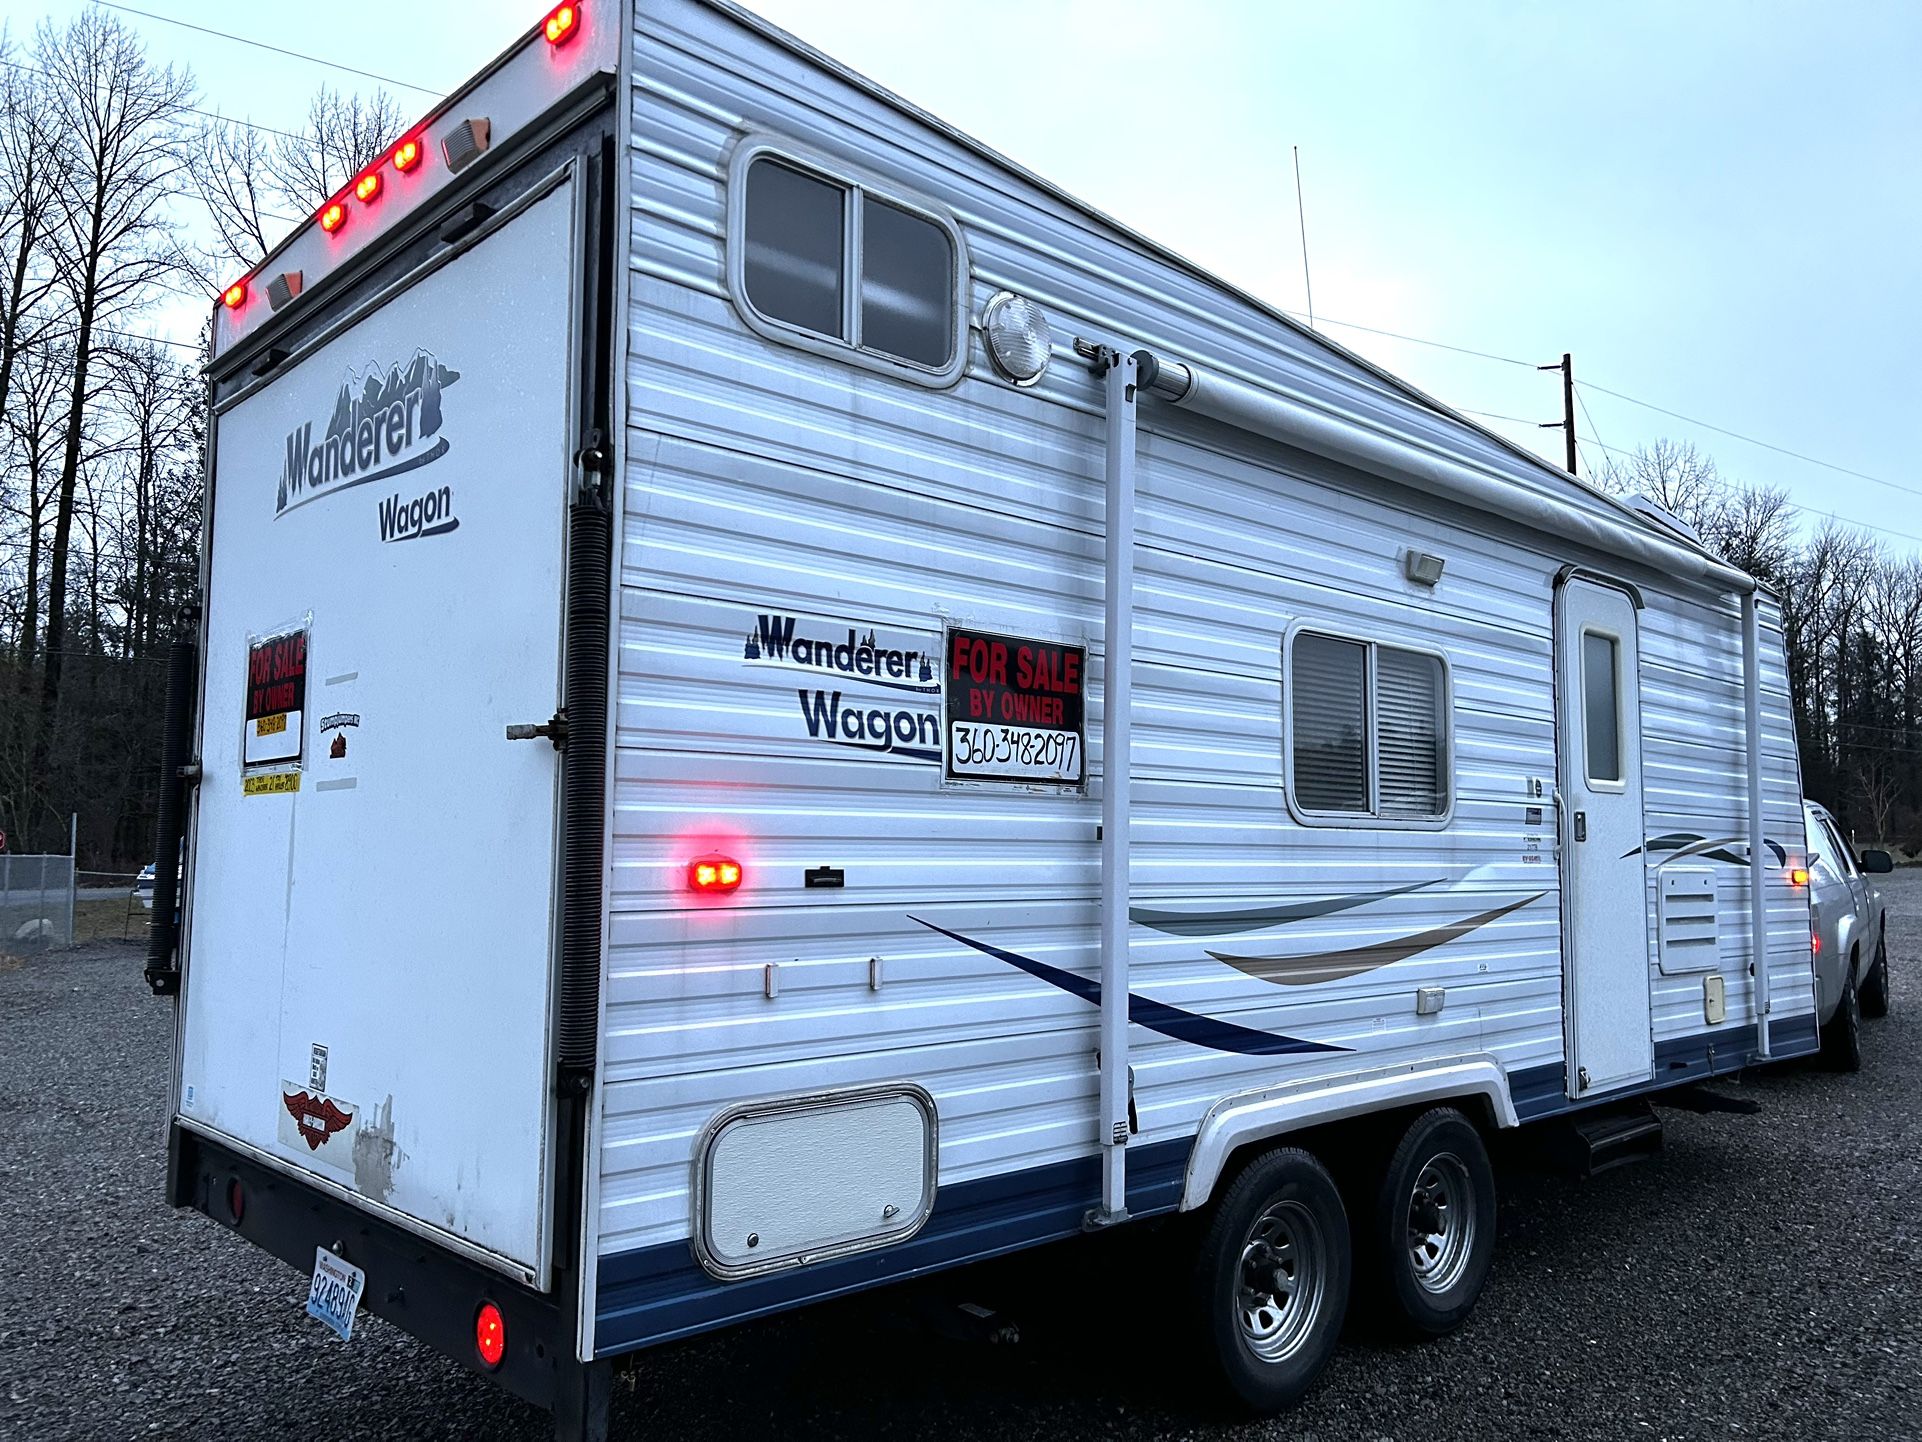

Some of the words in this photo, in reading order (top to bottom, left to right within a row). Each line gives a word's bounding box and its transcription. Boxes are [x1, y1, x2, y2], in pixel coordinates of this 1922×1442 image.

[286, 388, 422, 497] Wanderer
[378, 485, 451, 542] Wagon
[249, 646, 272, 687] FOR
[274, 636, 304, 681] SALE
[757, 613, 919, 679] Wanderer
[952, 637, 1007, 685] FOR
[1017, 645, 1080, 694] SALE
[253, 688, 265, 714] BY
[265, 682, 295, 711] OWNER
[798, 688, 940, 752] Wagon
[969, 688, 994, 719] BY
[1001, 692, 1064, 725] OWNER
